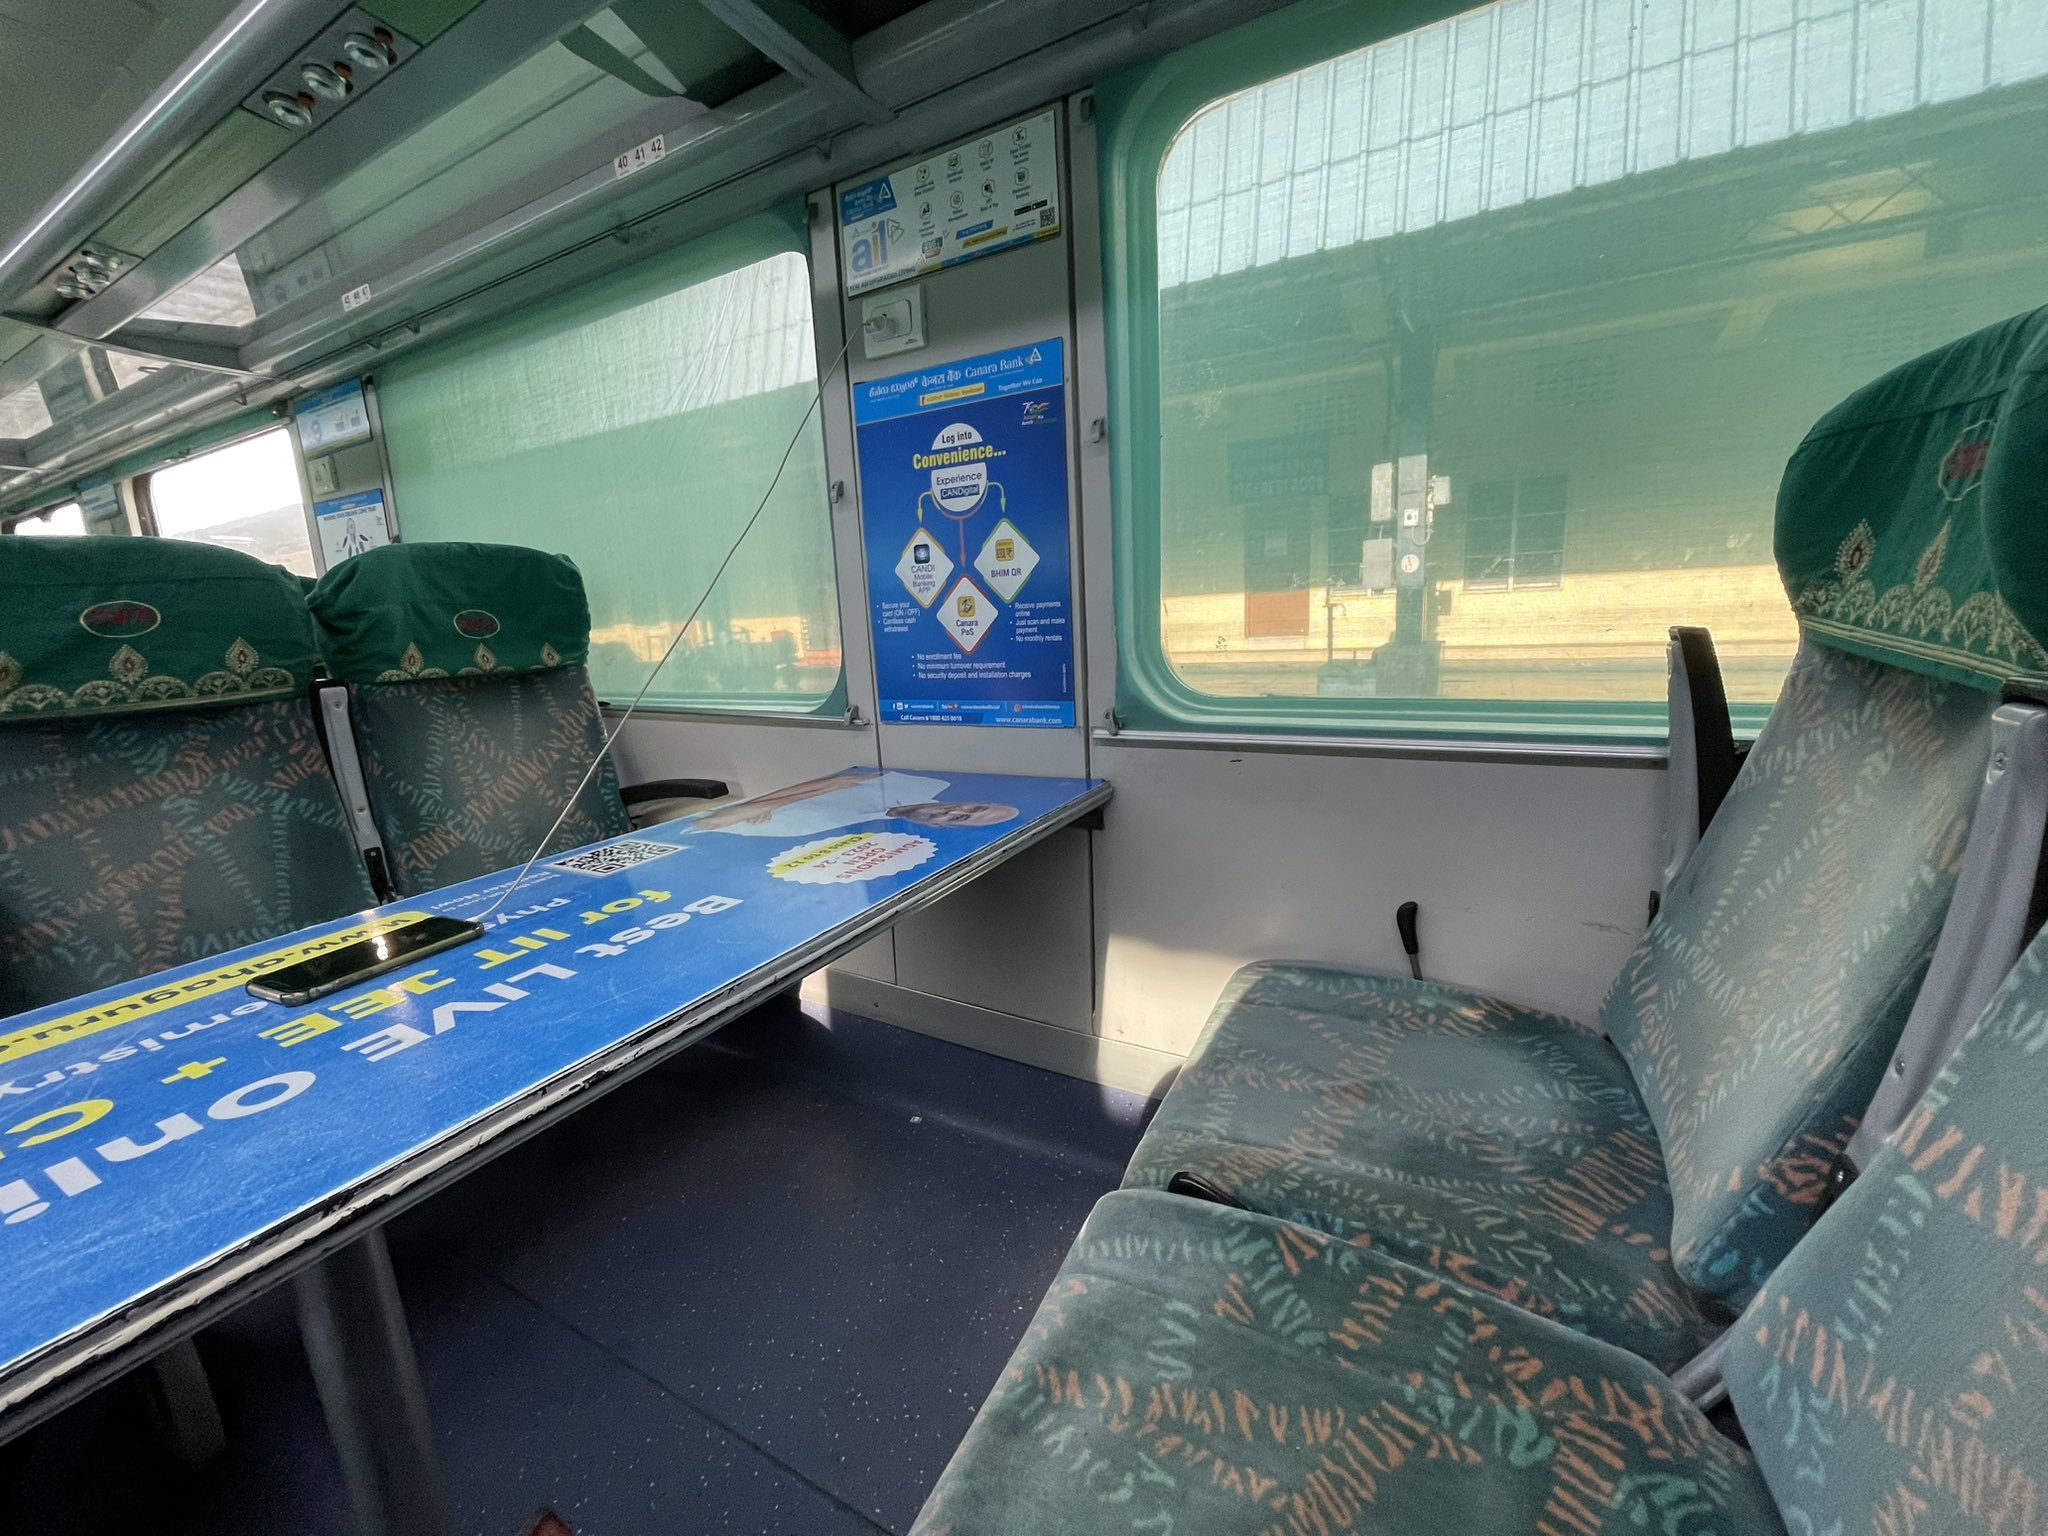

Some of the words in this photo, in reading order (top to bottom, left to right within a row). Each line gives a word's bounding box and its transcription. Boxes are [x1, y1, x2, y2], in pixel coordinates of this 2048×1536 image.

[618, 155, 628, 169] 40
[635, 147, 645, 160] 41
[651, 139, 662, 152] 42
[966, 360, 997, 378] Canara
[1001, 356, 1024, 371] Bank
[942, 434, 955, 444] Log
[957, 431, 972, 441] into
[913, 445, 1006, 470] Convenience...
[936, 472, 982, 487] Experience
[941, 485, 979, 498] CANDigital
[911, 565, 935, 574] CANDI
[991, 570, 1010, 578] BHIM
[1011, 569, 1022, 577] QR
[912, 580, 935, 588] Banking
[956, 619, 978, 628] Canara
[961, 628, 974, 636] PoS
[836, 839, 924, 880] ADMISSIONS
[841, 842, 879, 857] 2023
[843, 847, 886, 866] OPEN
[813, 859, 837, 869] 24
[483, 898, 571, 930] Phys
[578, 890, 672, 926] for
[575, 894, 744, 959] Best
[475, 928, 572, 970] IIT
[257, 972, 456, 1047] JEE
[342, 962, 578, 1062] LIVE
[0, 1001, 268, 1098] emistry
[161, 1056, 228, 1084] +
[0, 1099, 114, 1150] C
[0, 1070, 316, 1225] Onli
